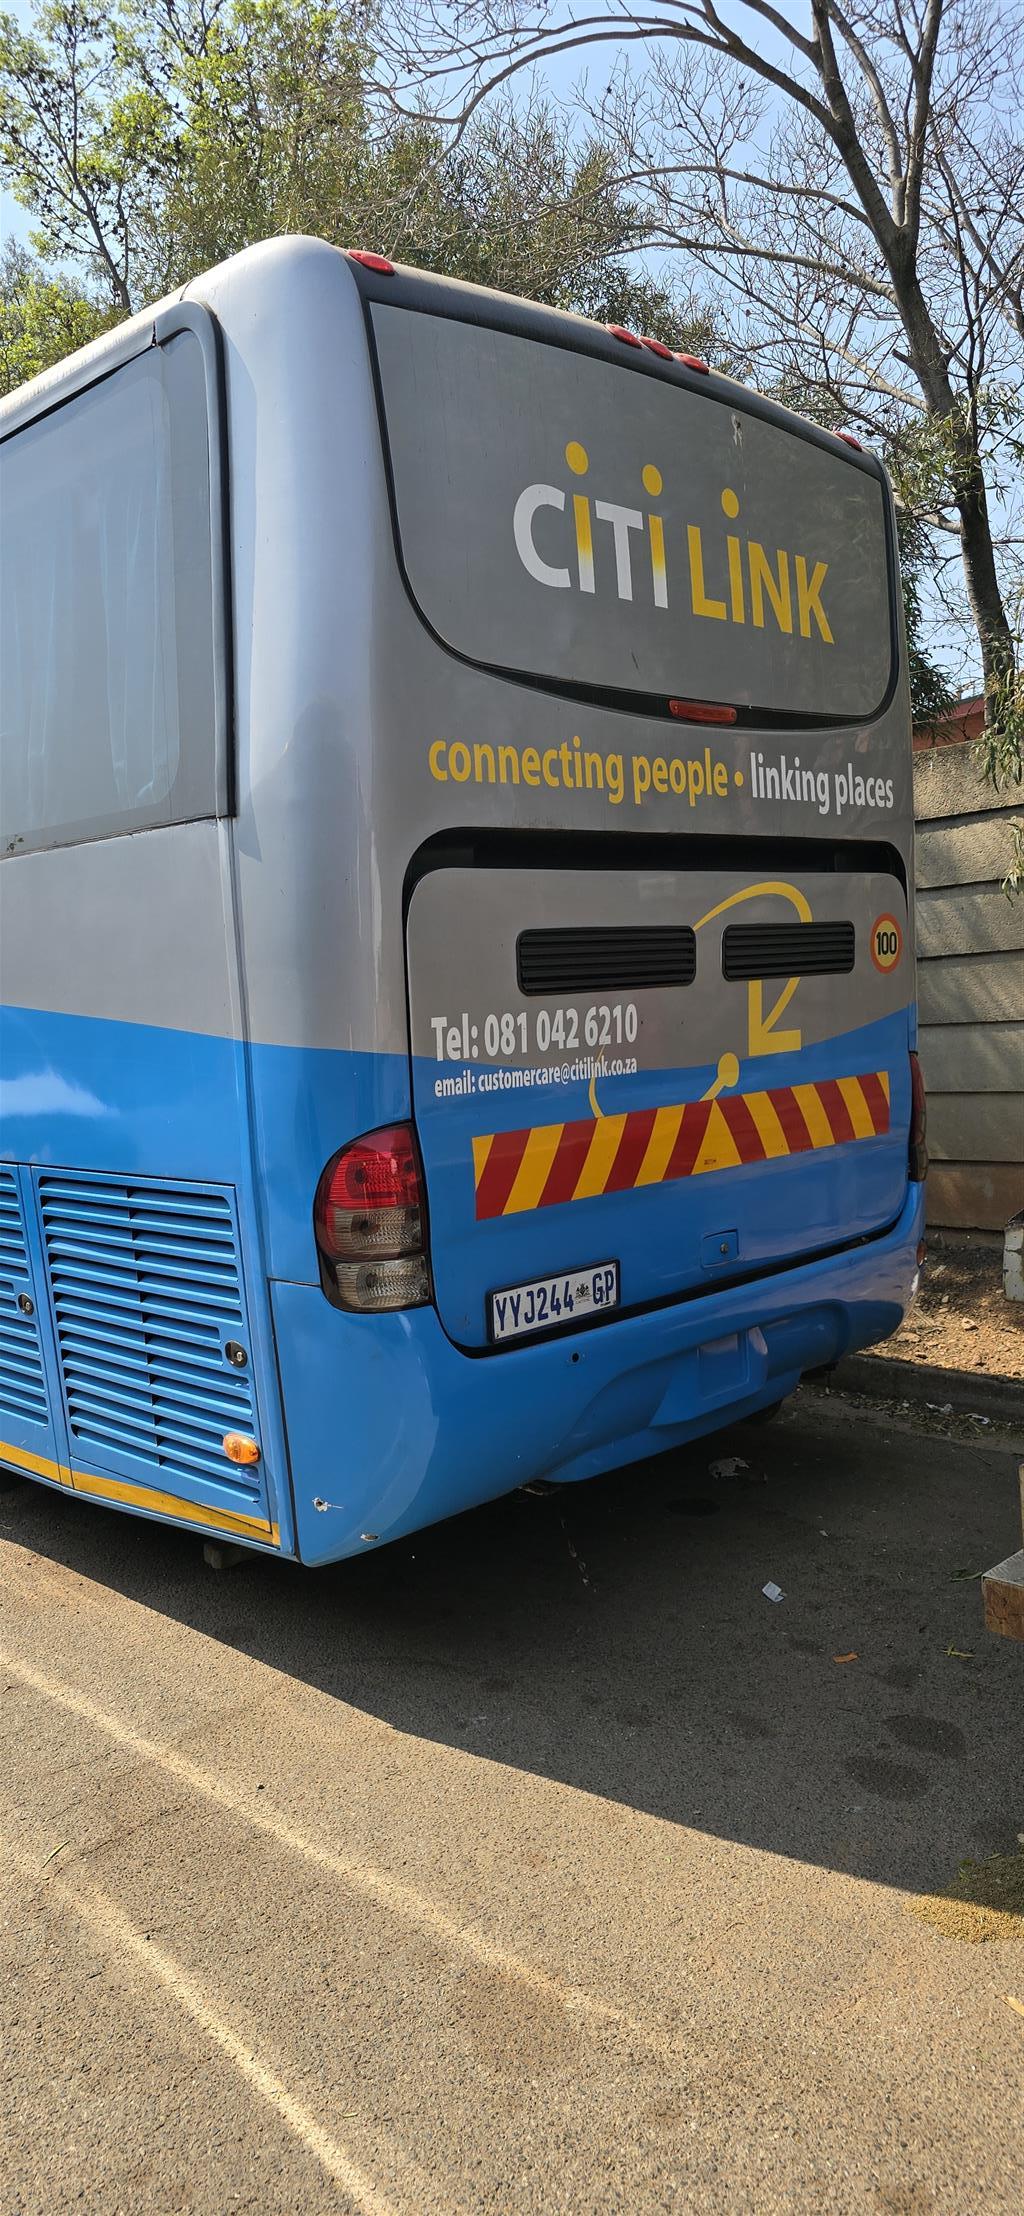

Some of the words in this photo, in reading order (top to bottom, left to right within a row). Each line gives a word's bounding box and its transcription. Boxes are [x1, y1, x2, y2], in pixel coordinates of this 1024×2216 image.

[428, 736, 625, 805] connecting
[632, 748, 728, 807] people
[750, 752, 830, 815] linking
[834, 763, 894, 815] places
[876, 931, 897, 955] 100
[431, 1013, 478, 1061] Tel:
[484, 1012, 528, 1056] 081
[536, 1008, 579, 1051] 042
[585, 1003, 637, 1047] 6210
[434, 1070, 476, 1097] email:
[478, 1057, 637, 1092] customercare@citilink.co.za
[495, 1281, 574, 1331] YYJ244
[592, 1270, 614, 1304] GP
